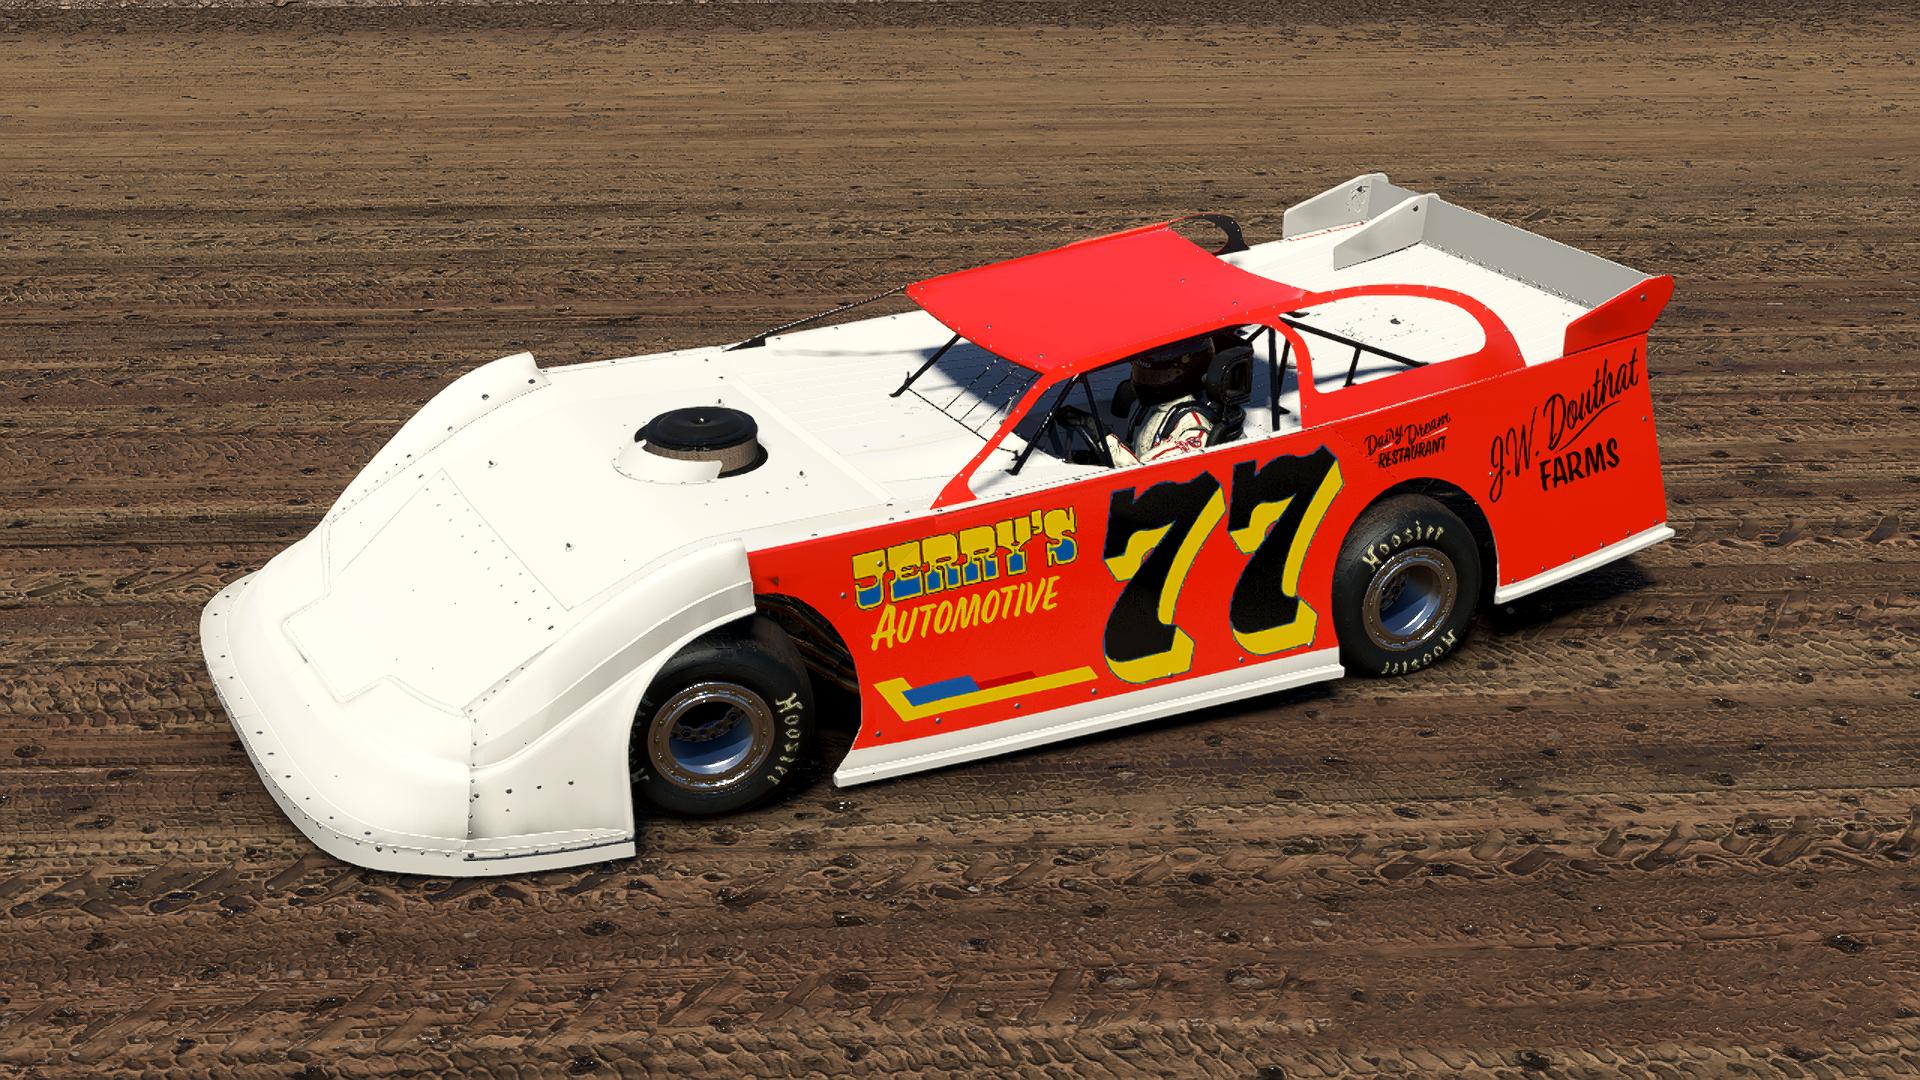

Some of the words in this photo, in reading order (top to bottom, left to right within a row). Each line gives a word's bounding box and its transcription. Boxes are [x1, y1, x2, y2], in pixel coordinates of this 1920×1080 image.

[1543, 347, 1639, 451] Douthat
[1364, 425, 1403, 456] Dairy
[1404, 412, 1451, 445] Dream
[1378, 436, 1446, 468] RESTAURANT
[1540, 437, 1620, 492] FARMS
[852, 505, 1078, 610] JERRY'S
[1102, 443, 1344, 684] 77
[1362, 520, 1444, 572] Hoosier
[871, 575, 1061, 651] AUTOMOTIVE
